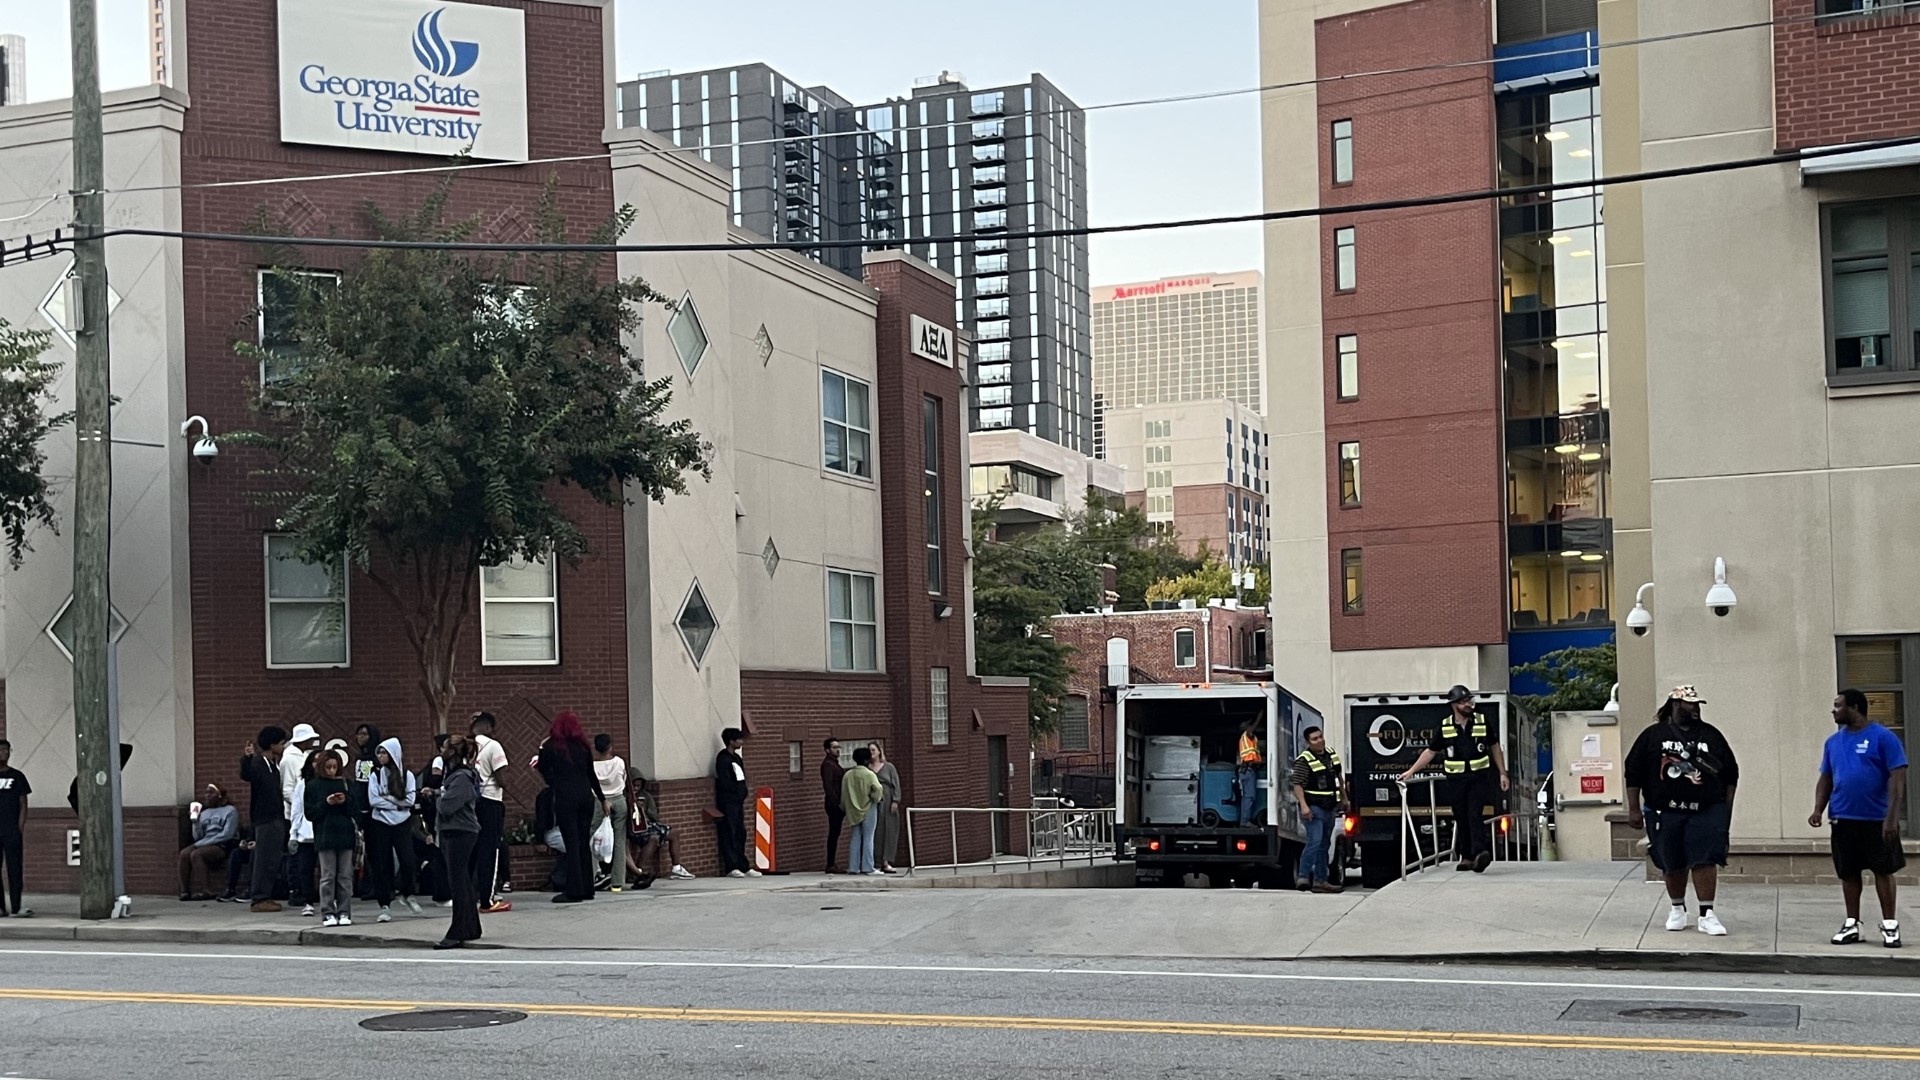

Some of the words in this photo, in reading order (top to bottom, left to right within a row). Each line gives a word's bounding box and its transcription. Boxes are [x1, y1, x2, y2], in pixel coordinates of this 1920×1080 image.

[334, 100, 482, 142] University
[1112, 282, 1166, 301] Marriott
[1167, 276, 1211, 289] MARQUIS
[1368, 773, 1388, 781] 24/7
